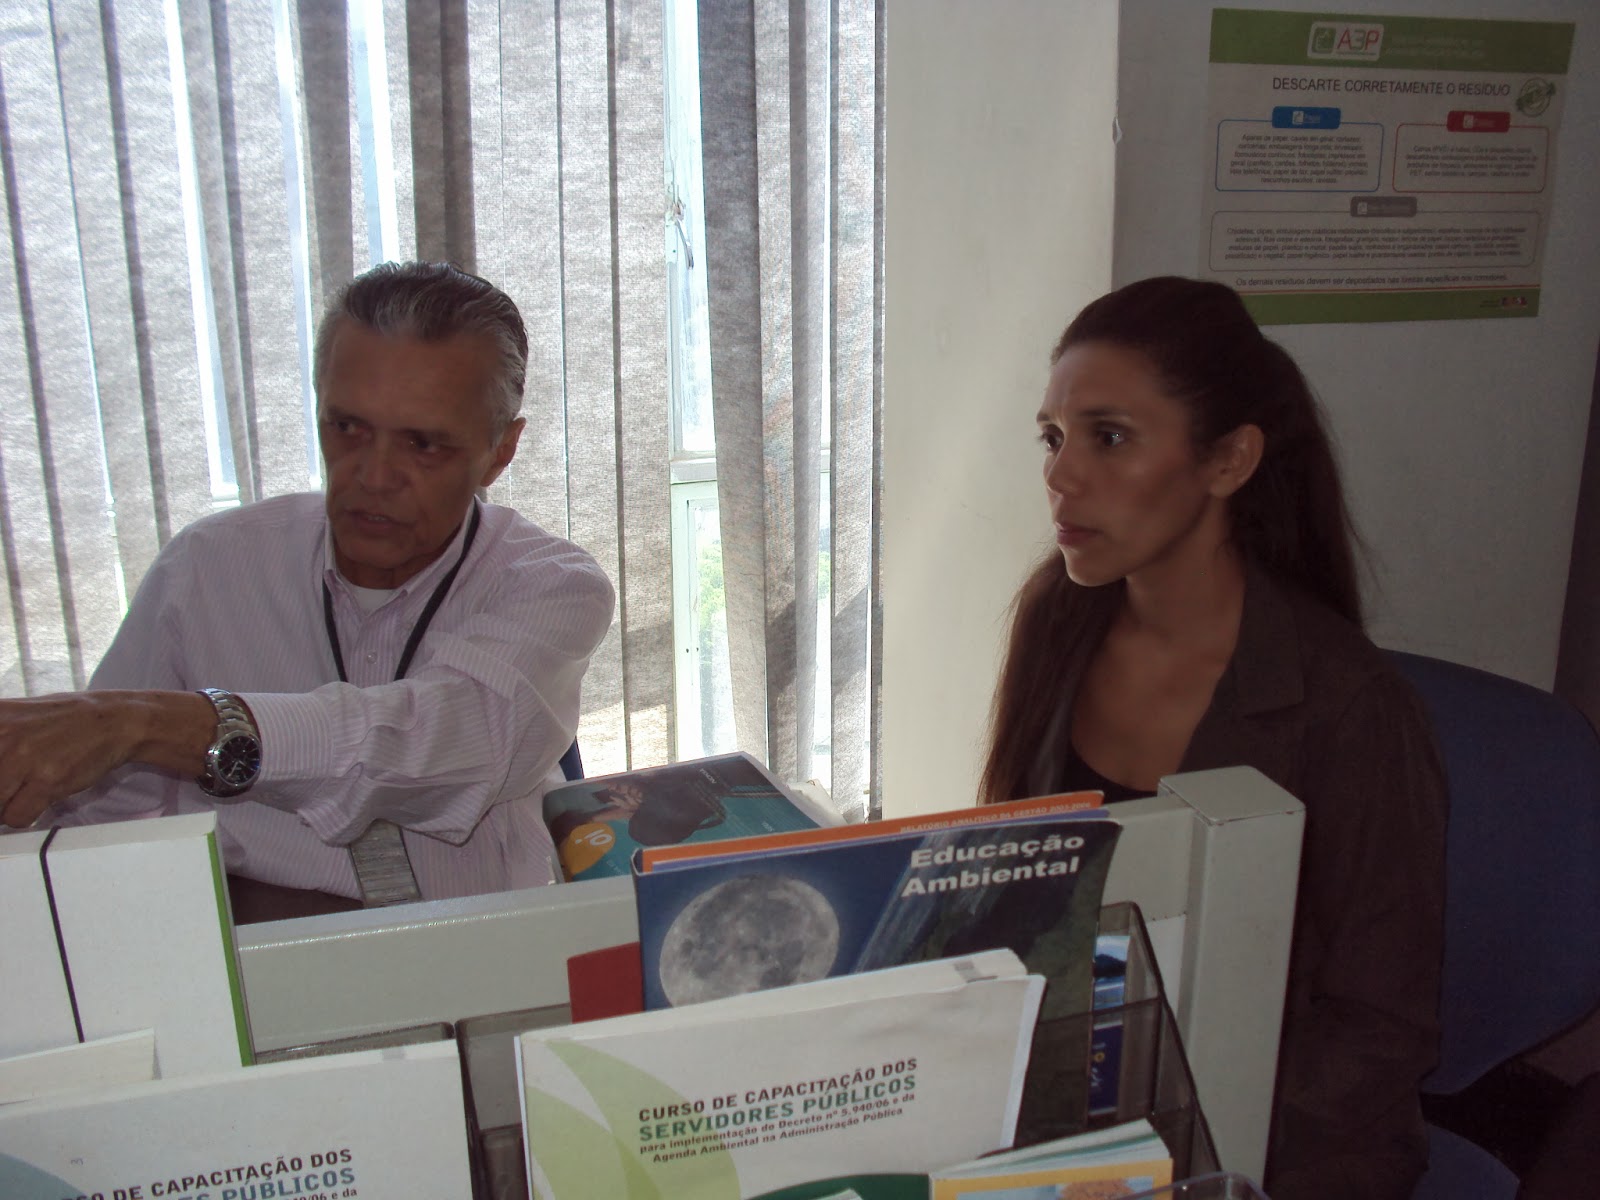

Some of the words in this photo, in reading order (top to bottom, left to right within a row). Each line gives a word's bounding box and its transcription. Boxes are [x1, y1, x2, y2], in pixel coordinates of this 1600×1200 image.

[1337, 28, 1379, 50] A3P
[1273, 78, 1340, 91] DESCARTE
[1345, 80, 1442, 94] CORRETAMENTE
[1446, 83, 1454, 94] O
[1459, 82, 1510, 96] RESÍDUO
[1236, 278, 1246, 286] Os
[1248, 277, 1273, 285] demais
[1306, 277, 1330, 285] devem
[910, 834, 1084, 868] Educação
[901, 856, 1080, 897] Ambiental
[639, 1099, 705, 1122] CURSO
[712, 1094, 738, 1111] DE
[745, 1067, 876, 1105] CAPACITAÇÃO
[882, 1057, 917, 1077] DOS
[640, 1102, 793, 1141] SERVIDORES
[803, 1075, 916, 1114] PÚBLICOS
[640, 1143, 666, 1154] para
[669, 1125, 757, 1147] implementação
[761, 1123, 775, 1132] do
[779, 1115, 822, 1129] Decreto
[842, 1099, 889, 1117] 5.940/06
[902, 1093, 915, 1103] da
[653, 1147, 697, 1162] Agenda
[700, 1137, 759, 1155] Ambiental
[763, 1132, 776, 1142] na
[779, 1116, 860, 1139] Administração
[863, 1107, 903, 1123] Pública
[113, 1186, 143, 1200] DE
[151, 1156, 303, 1197] CAPACITAÇÃO
[310, 1149, 353, 1168] DOS
[222, 1168, 356, 1200] PÚBLICOS
[332, 1192, 338, 1200] e
[342, 1187, 358, 1198] da
